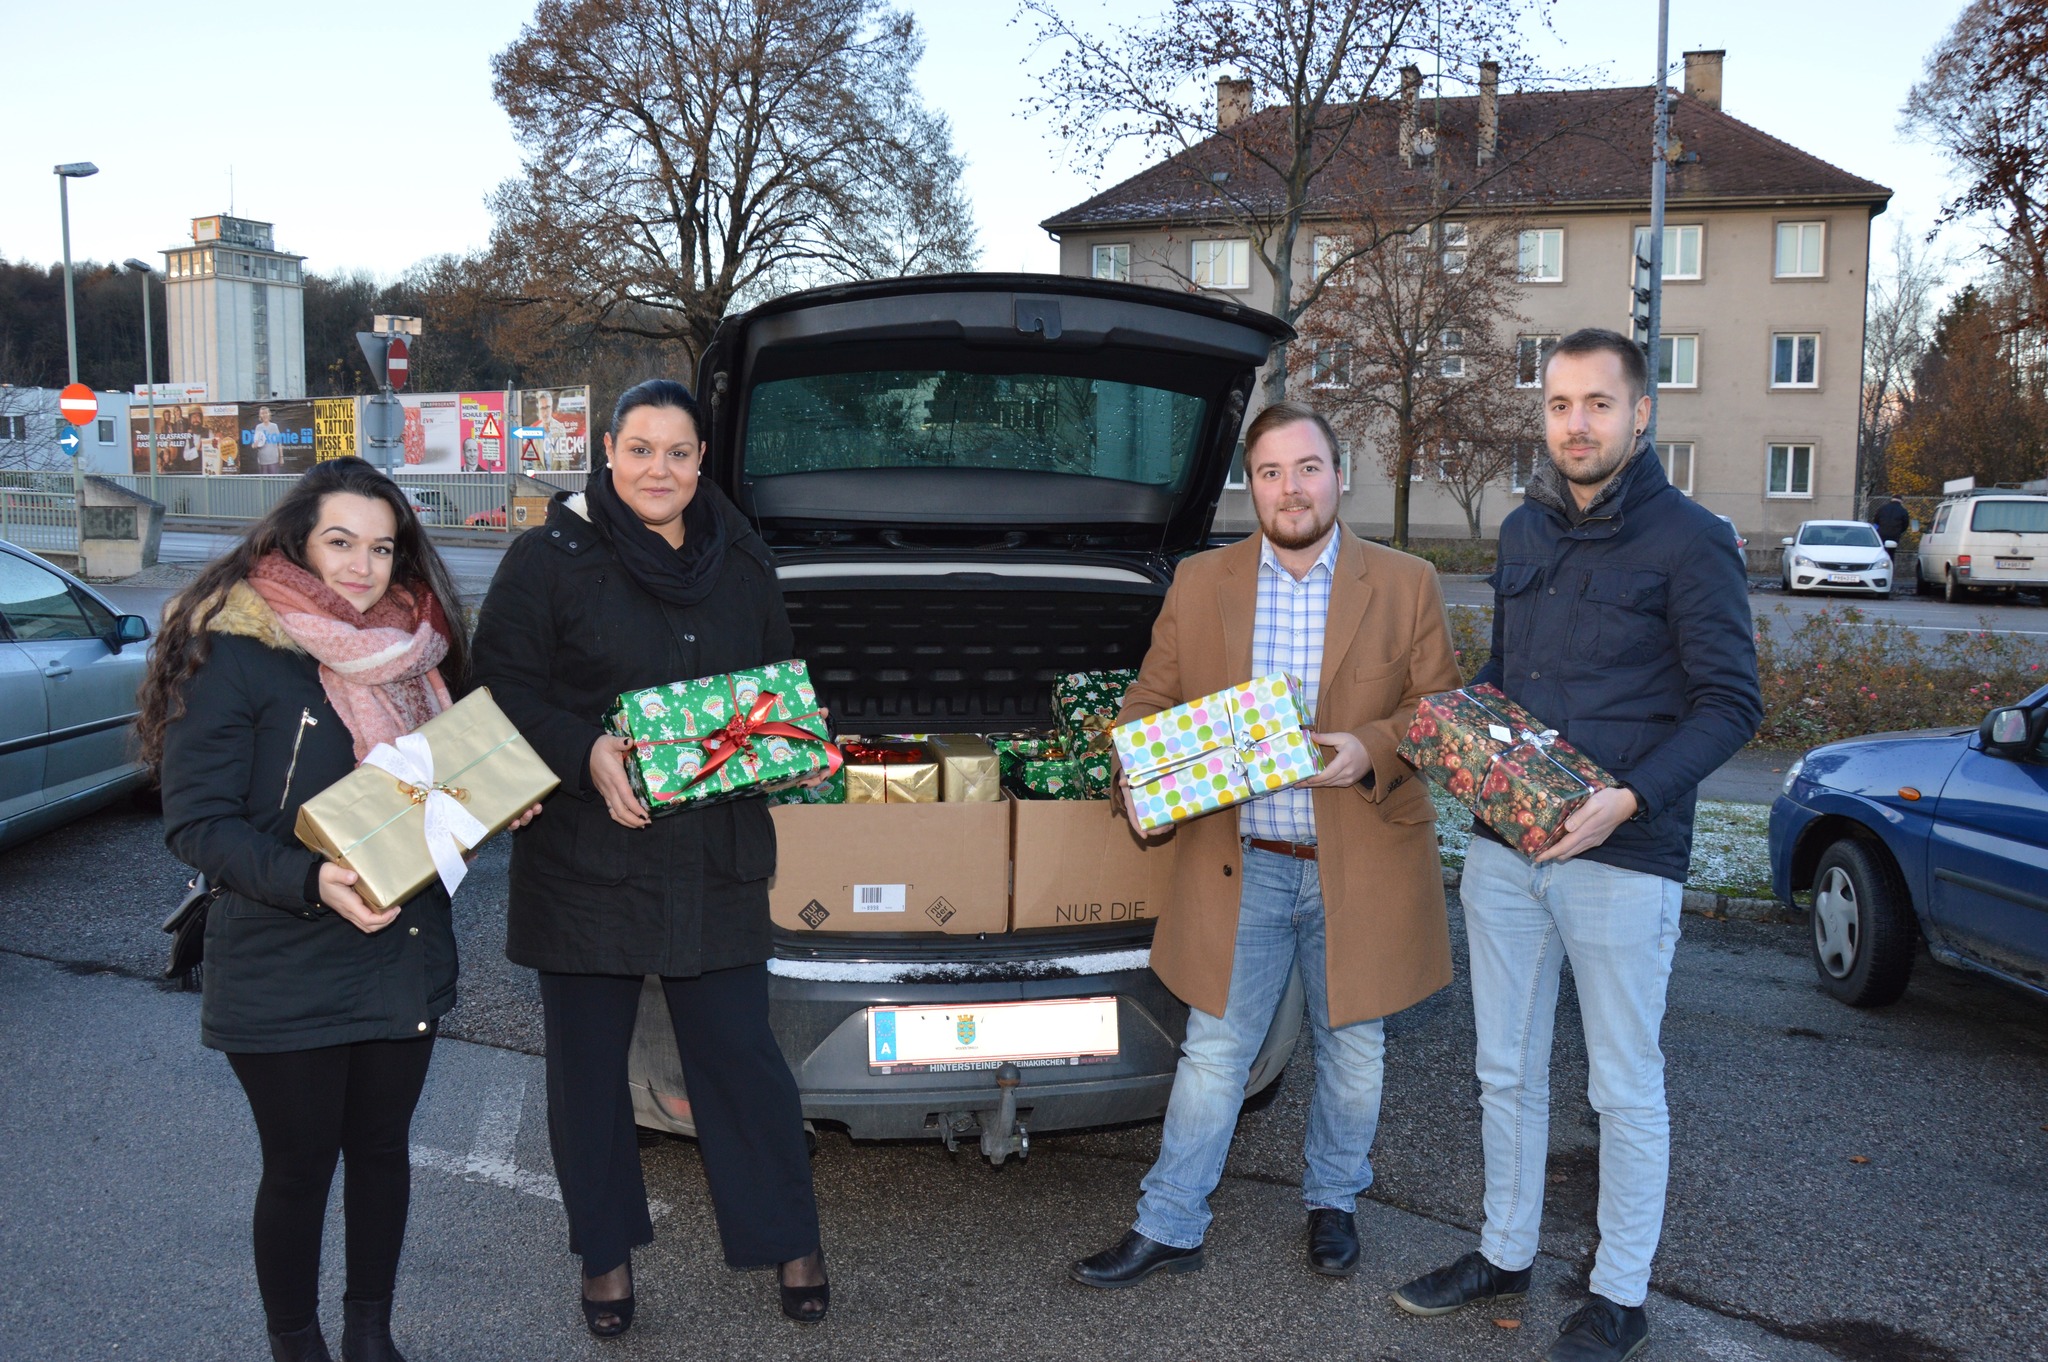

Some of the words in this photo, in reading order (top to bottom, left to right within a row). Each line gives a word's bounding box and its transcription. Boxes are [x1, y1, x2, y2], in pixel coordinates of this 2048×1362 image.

[315, 403, 353, 419] WILDSTYLE
[316, 422, 322, 434] &
[324, 420, 354, 434] TATTOO
[242, 428, 298, 445] Dikonie
[316, 436, 341, 450] MESSE
[802, 902, 818, 919] nur
[930, 900, 943, 914] nur
[936, 906, 948, 918] der
[1056, 904, 1102, 922] NUR
[1111, 902, 1146, 920] DIE
[810, 910, 826, 926] die
[880, 1042, 892, 1054] A
[930, 1061, 1002, 1072] HINTERSTEINER
